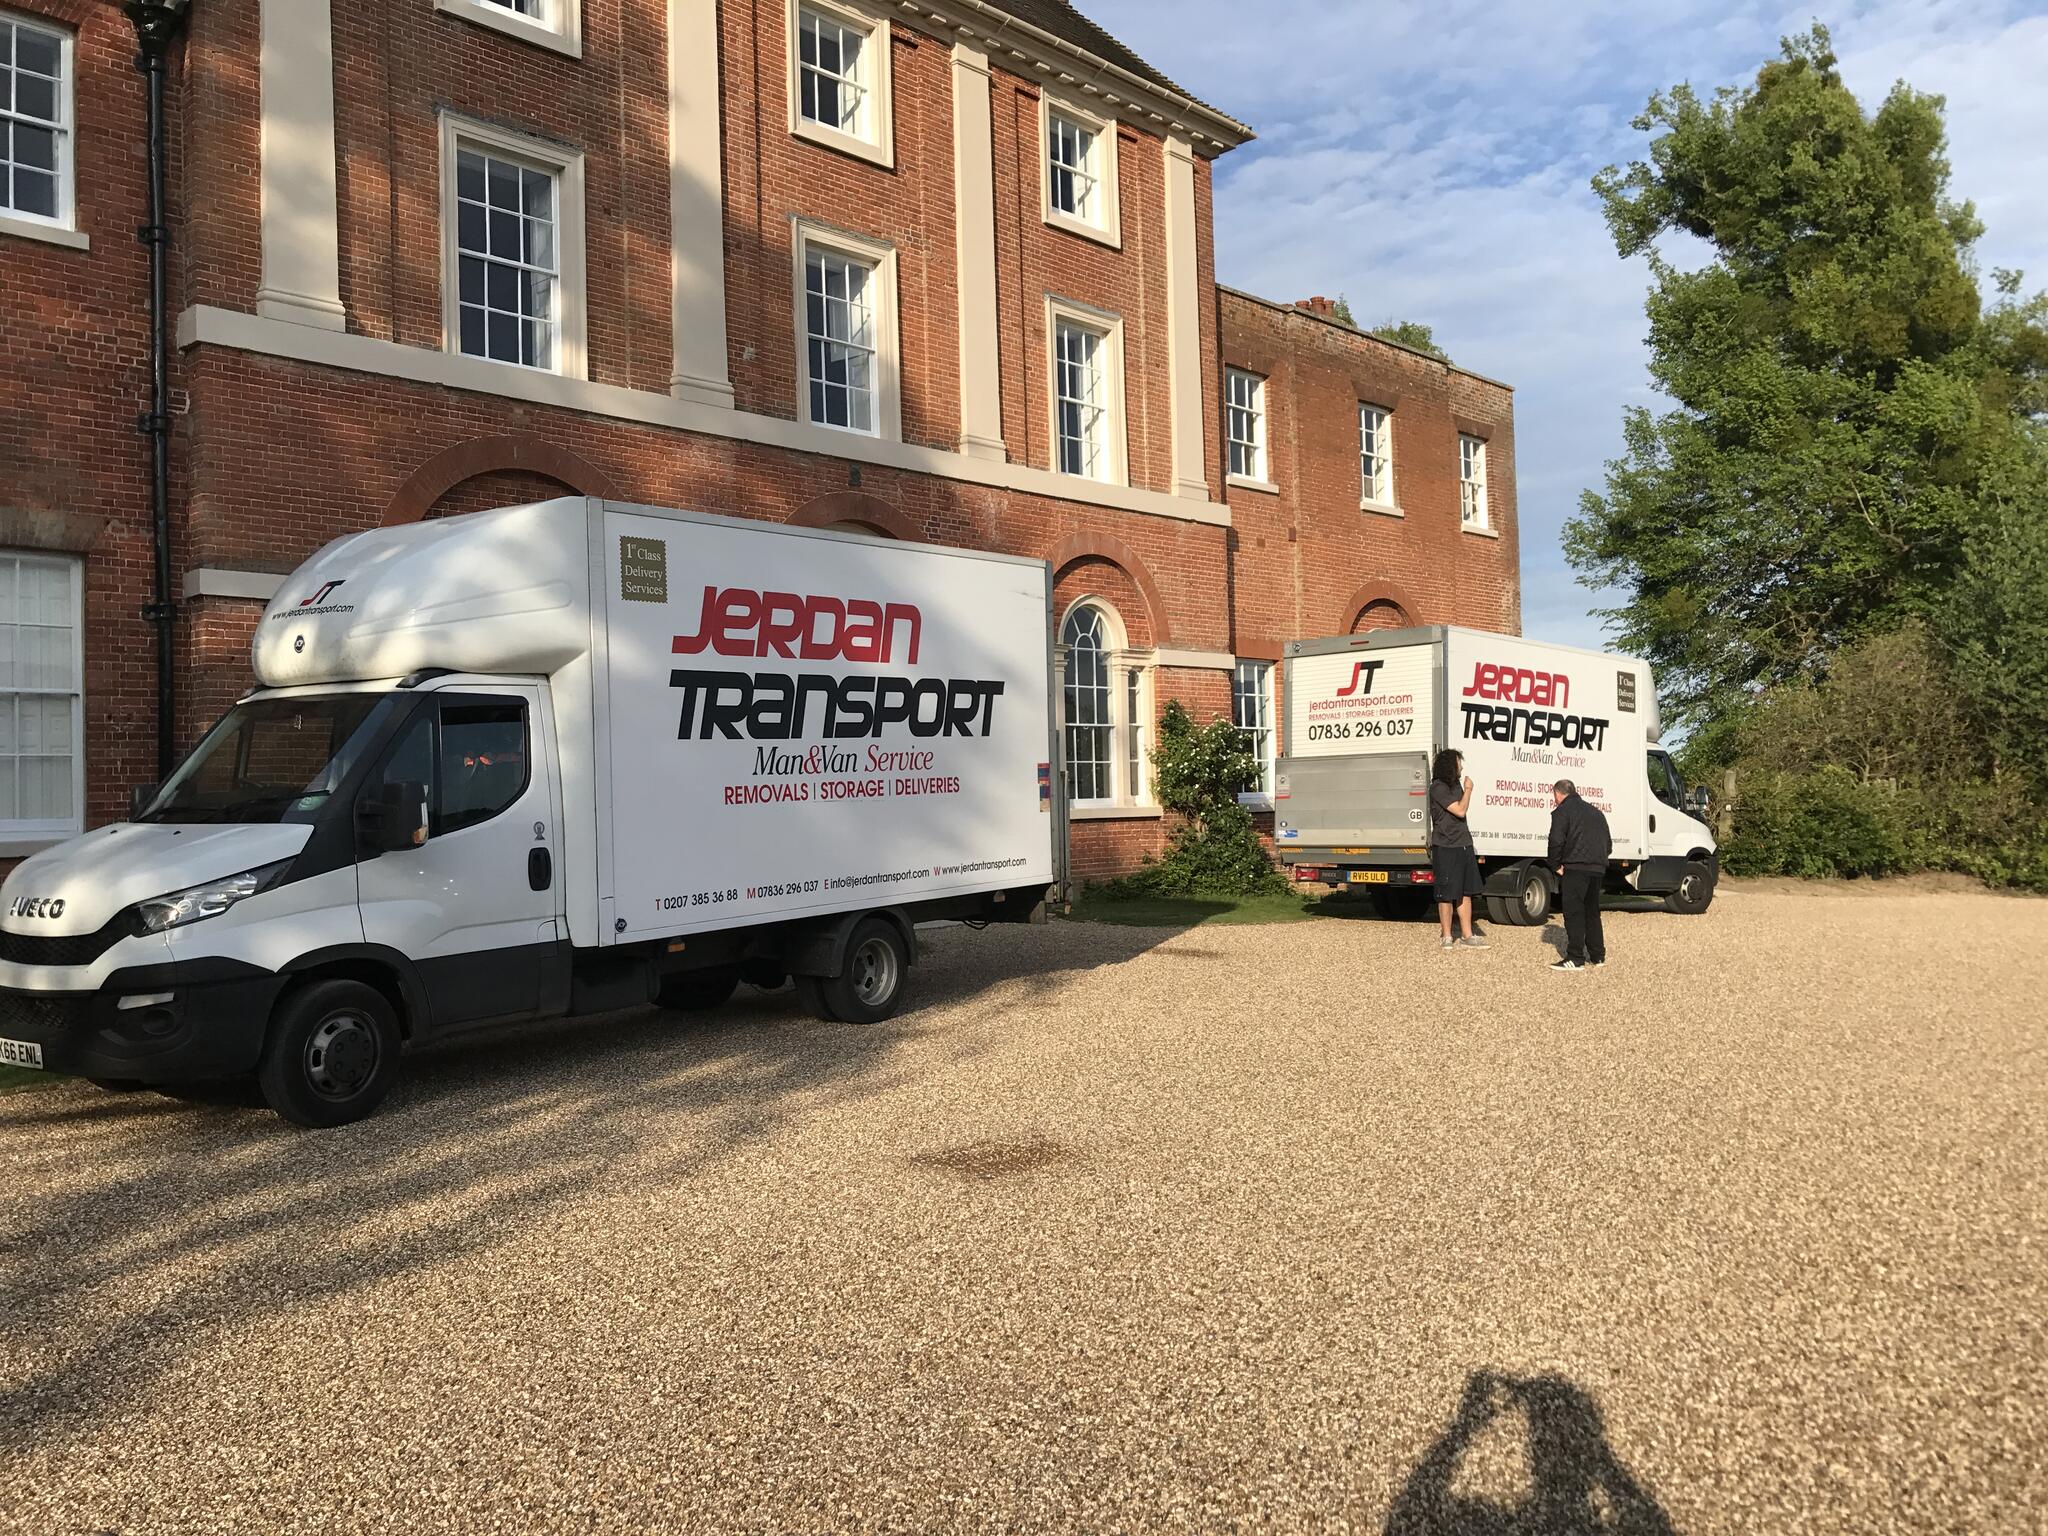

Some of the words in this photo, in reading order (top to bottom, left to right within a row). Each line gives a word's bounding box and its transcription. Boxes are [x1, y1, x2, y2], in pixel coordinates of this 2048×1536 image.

[637, 548, 662, 562] Class
[625, 564, 663, 581] Delivery
[625, 581, 664, 595] Services
[272, 604, 354, 620] www.jerdantransport.com
[1336, 660, 1384, 696] JT
[1309, 694, 1414, 713] jerdantransport.com
[1308, 712, 1341, 721] REMOVALS
[1345, 709, 1375, 719] STORAGE
[1379, 706, 1414, 716] DELIVERIES
[1308, 723, 1351, 741] 07836
[1355, 721, 1382, 738] 296
[1387, 719, 1414, 736] 037
[752, 745, 857, 776] Man&Van
[864, 744, 934, 773] Service
[1556, 751, 1586, 768] Service
[724, 783, 809, 805] REMOVALS
[820, 780, 884, 800] STORAGE
[895, 776, 960, 796] DELIVERIES
[1496, 780, 1533, 793] REMOVALS
[1537, 783, 1554, 794] STOR
[1576, 786, 1604, 799] ELIVERIES
[1486, 795, 1513, 807] EXPORT
[1514, 797, 1545, 809] PACKING
[1409, 811, 1423, 820] GB
[655, 899, 662, 911] T
[664, 896, 688, 910] 0207
[691, 892, 709, 906] 385
[712, 890, 724, 903] 36
[726, 888, 738, 901] 88
[757, 884, 784, 898] 07836
[786, 882, 801, 895] 296
[803, 880, 819, 893] 037
[824, 879, 829, 890] E
[830, 868, 930, 889] info@jerdantransport.com
[933, 866, 941, 876] W
[942, 856, 1027, 875] www.jerdantransport.com
[1352, 872, 1369, 881] RV15
[1370, 873, 1386, 882] ULO
[10, 896, 65, 919] IVECO
[18, 1043, 41, 1065] ENL
